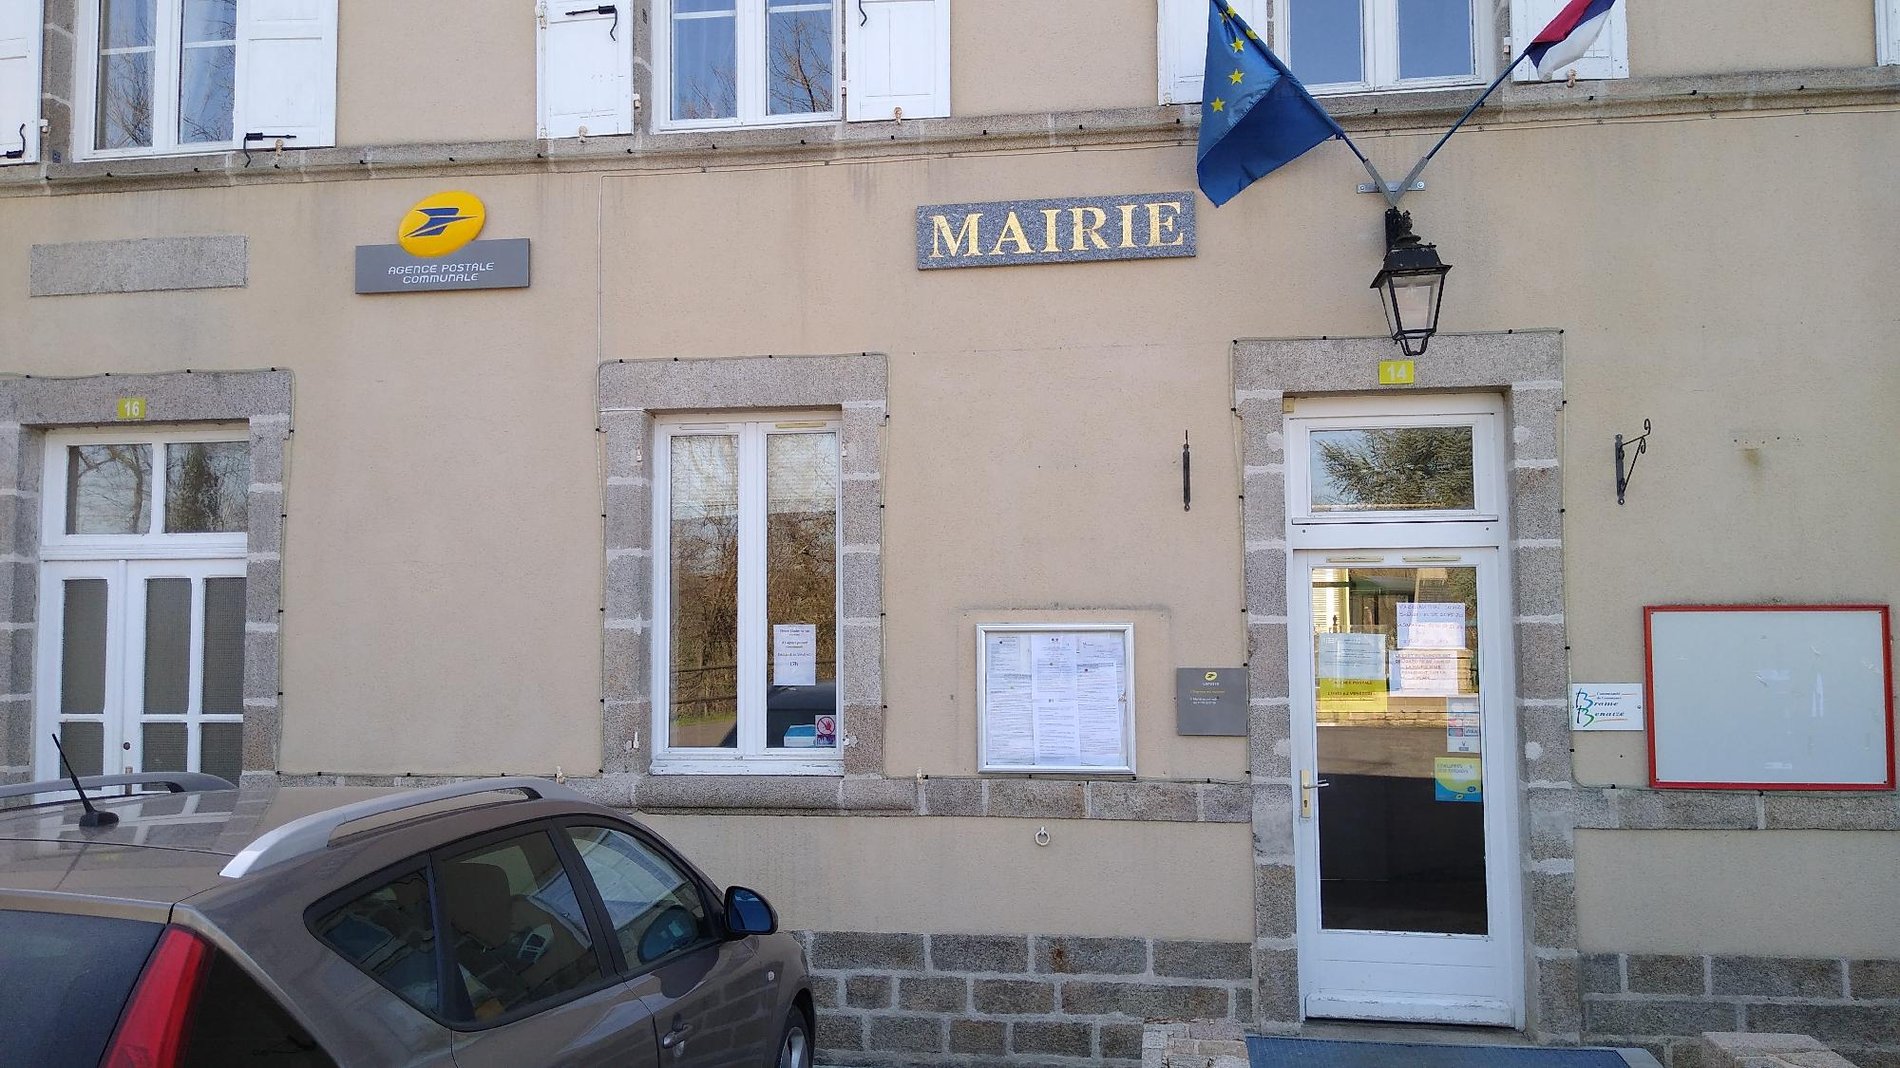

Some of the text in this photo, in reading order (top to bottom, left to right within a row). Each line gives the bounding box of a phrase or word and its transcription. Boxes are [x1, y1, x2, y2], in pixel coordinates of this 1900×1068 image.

[928, 201, 1184, 258] MAIRIE
[388, 262, 495, 275] AGENCE POSTALE
[403, 273, 479, 284] COMMUNALE
[1387, 364, 1408, 381] 14
[125, 401, 140, 417] 16
